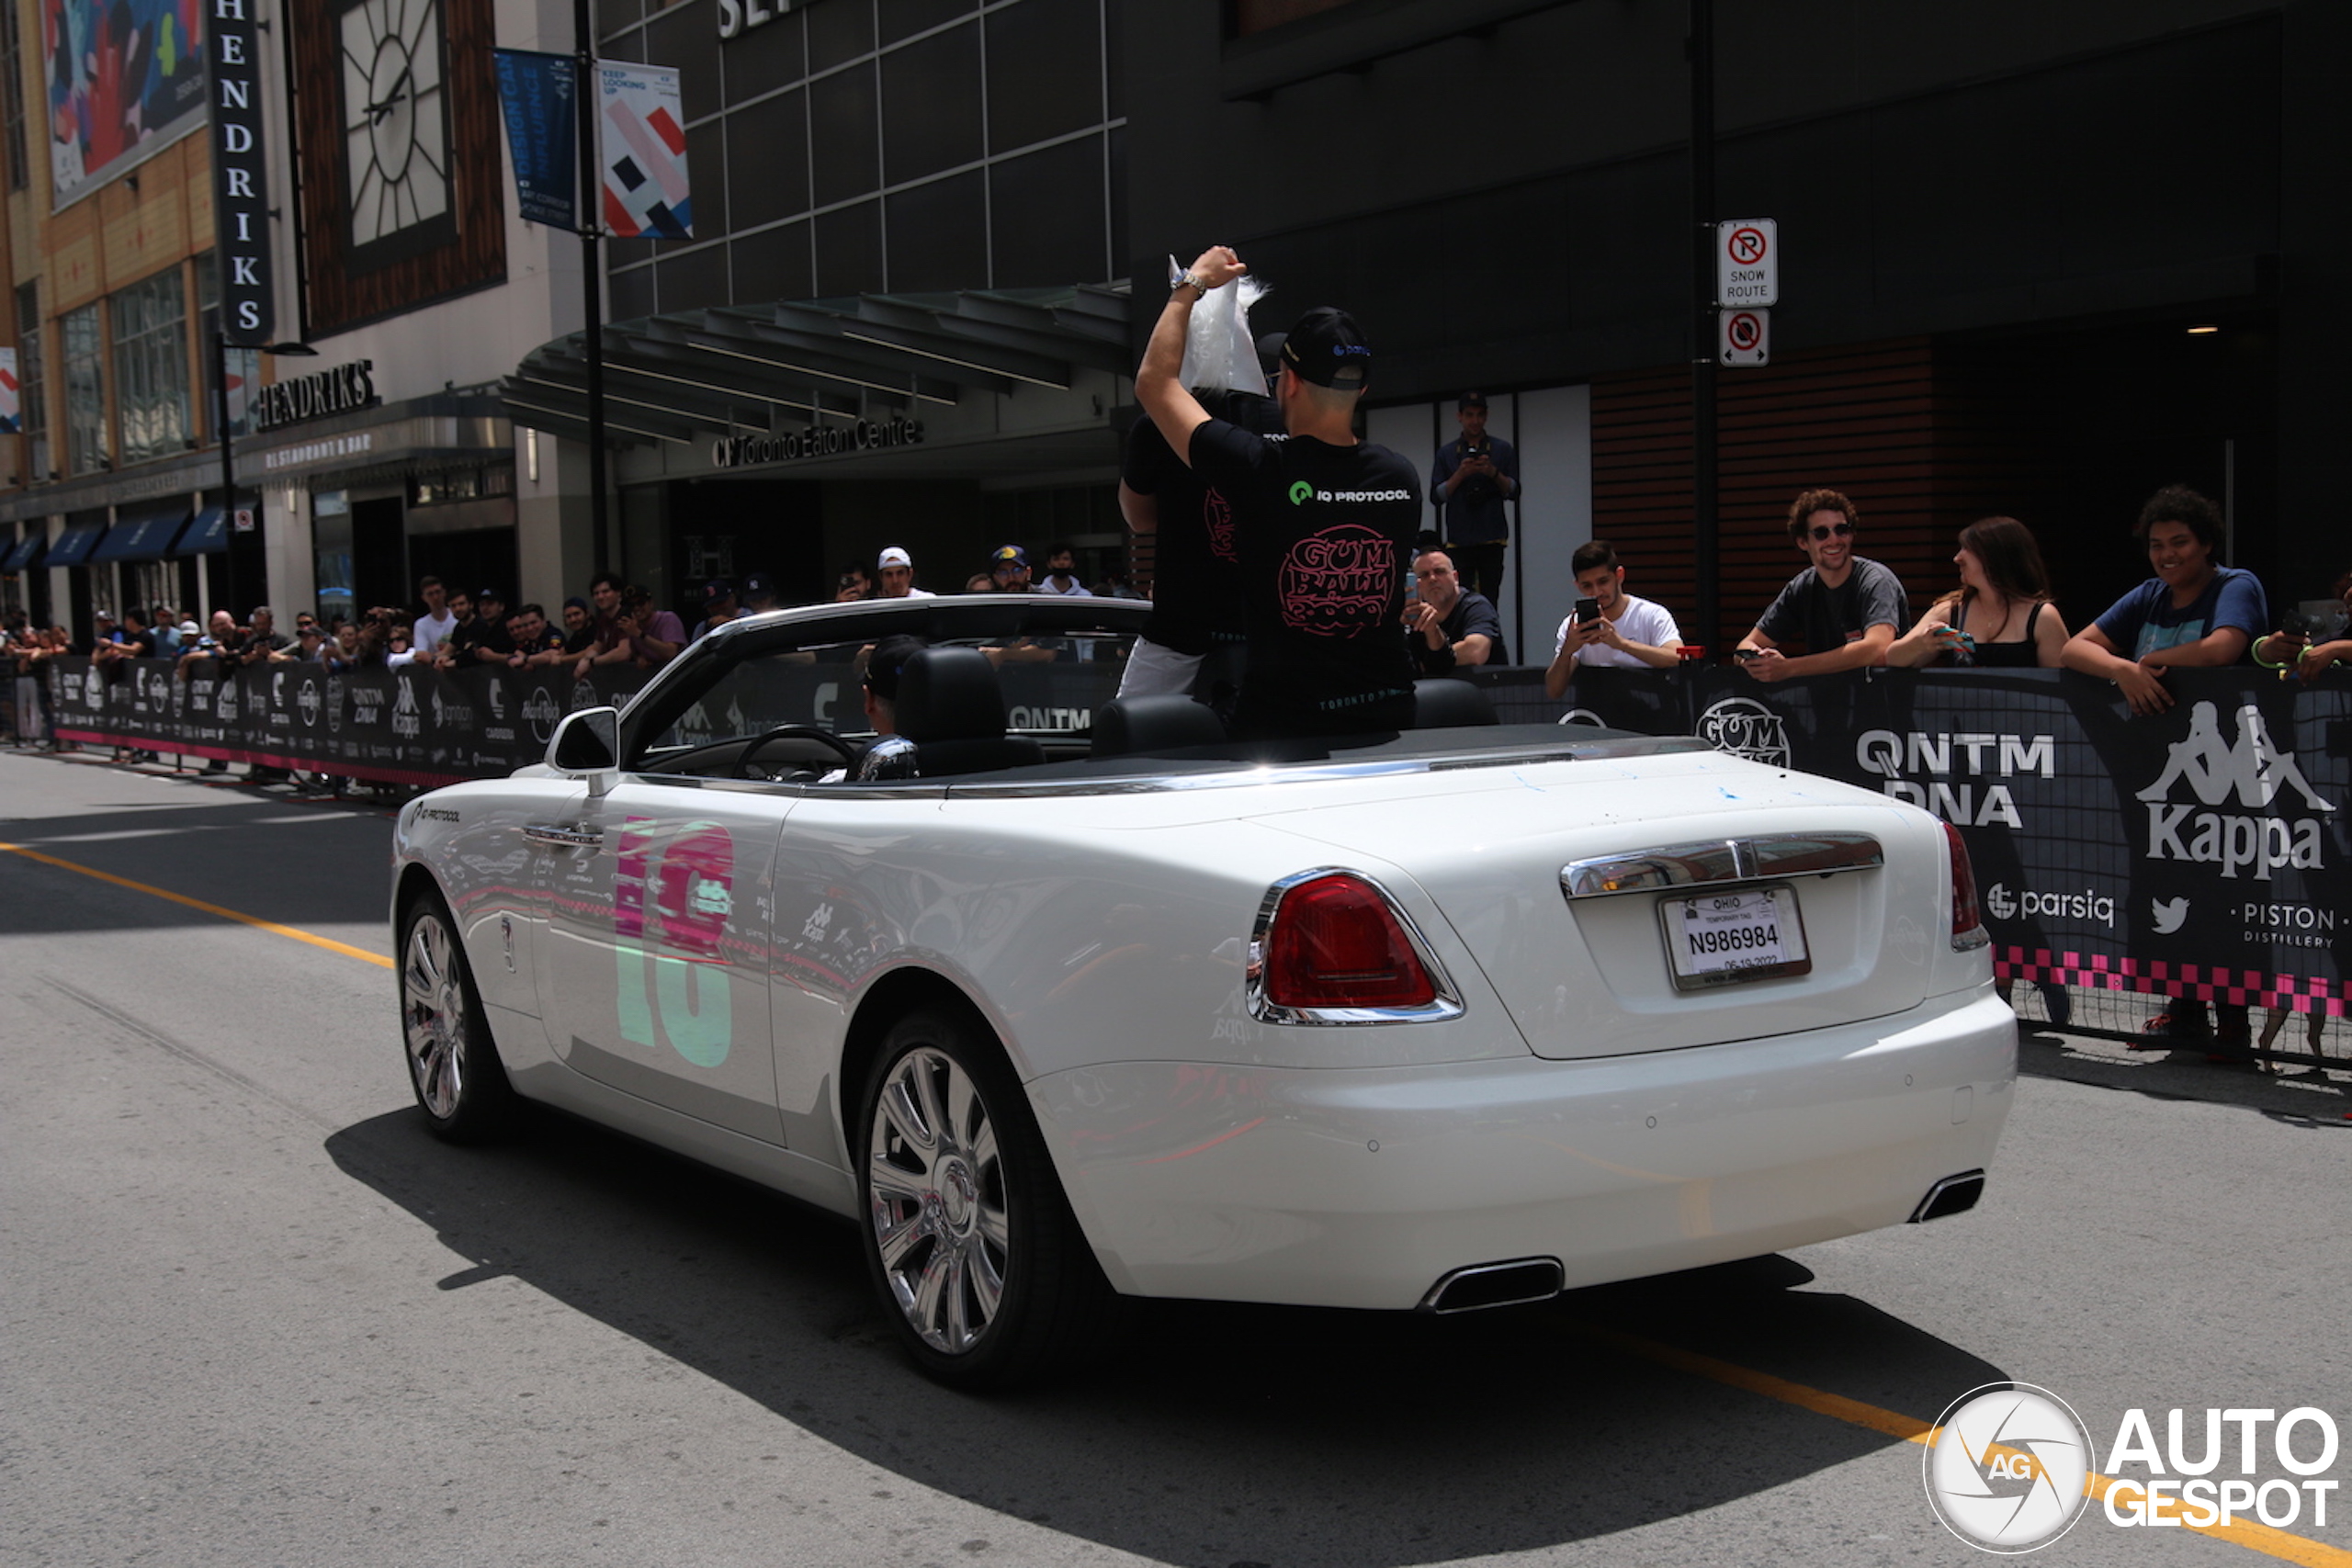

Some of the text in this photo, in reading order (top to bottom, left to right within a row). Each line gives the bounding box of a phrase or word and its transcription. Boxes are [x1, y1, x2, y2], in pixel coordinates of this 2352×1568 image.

[603, 70, 627, 79] KEEP
[603, 78, 646, 90] LOOKING
[215, 0, 261, 332] HENDRIKS
[1731, 270, 1766, 283] SNOW
[1727, 285, 1769, 299] ROUTE
[258, 359, 373, 428] HENDRIKS
[737, 433, 798, 466] Toronto
[802, 425, 850, 457] Eaton
[854, 416, 917, 451] Centre
[1317, 489, 1412, 503] IQ PROTOCOL
[1210, 631, 1248, 641] TORON
[1318, 693, 1375, 711] TORONTO
[1009, 705, 1091, 731] QNTM
[1854, 728, 2056, 780] QNTM
[1883, 779, 2024, 829] DNA
[2144, 801, 2325, 881] Kappa
[1713, 897, 1741, 910] OHIO
[2021, 887, 2114, 929] parsiq
[1705, 914, 1738, 924] TEMPORARY
[2243, 902, 2335, 931] PISTON
[1689, 923, 1779, 955] N986984
[2243, 930, 2335, 950] DISTILLERY
